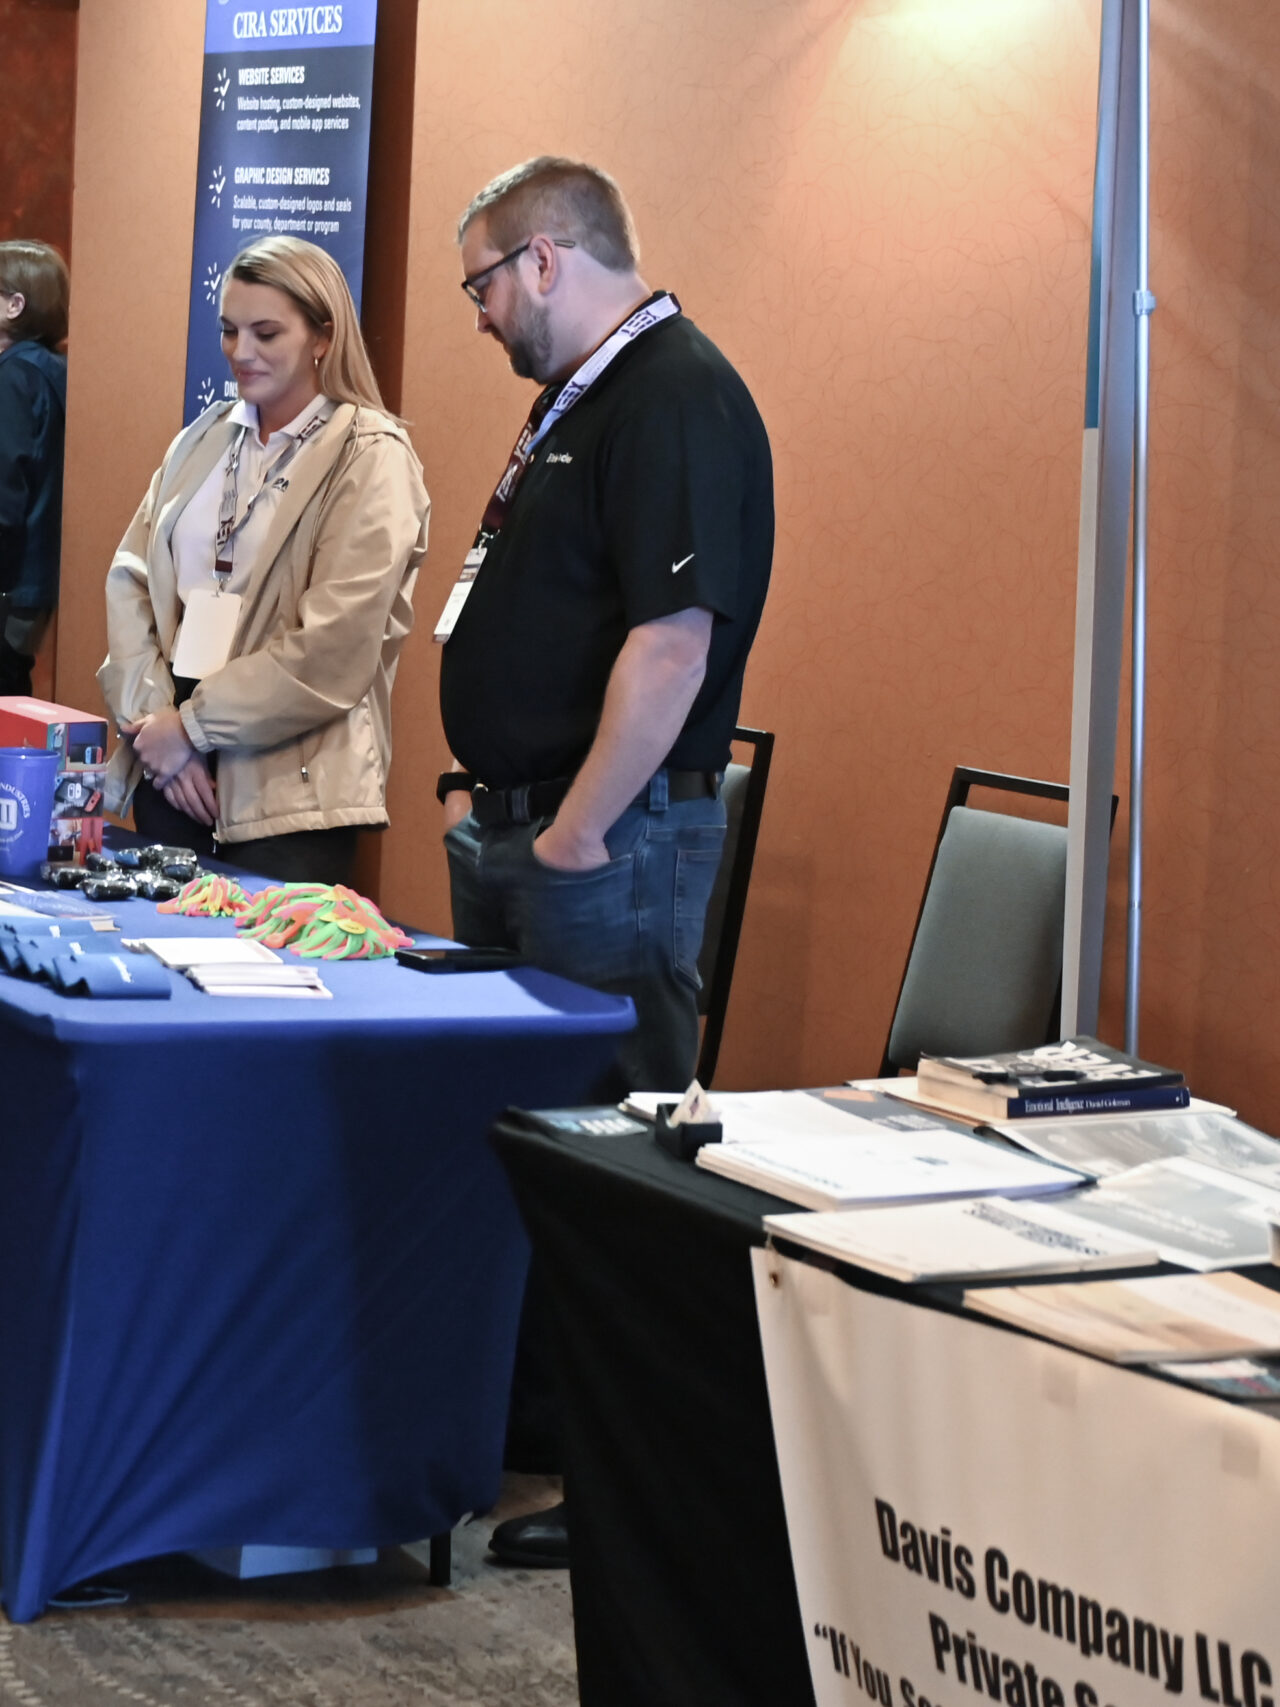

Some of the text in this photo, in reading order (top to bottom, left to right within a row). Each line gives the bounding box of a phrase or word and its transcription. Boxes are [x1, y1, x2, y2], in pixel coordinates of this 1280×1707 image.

[233, 5, 342, 38] CIRA SERVICES
[238, 66, 305, 85] WEBSITE SERVICES
[280, 116, 291, 130] and
[291, 116, 310, 130] mobile
[312, 118, 323, 132] app
[324, 115, 349, 130] services
[234, 167, 330, 185] GRAPHIC DESIGN SERVICES
[307, 196, 322, 214] logos
[324, 197, 335, 212] and
[336, 197, 352, 212] seals
[232, 214, 240, 229] for
[241, 218, 253, 232] your
[273, 216, 306, 232] department
[307, 219, 314, 231] or
[314, 220, 339, 235] program
[875, 1497, 976, 1600] Davis
[985, 1547, 1184, 1695] Company
[1195, 1630, 1275, 1707] LLC
[928, 1611, 1066, 1707] Private
[850, 1639, 892, 1707] You
